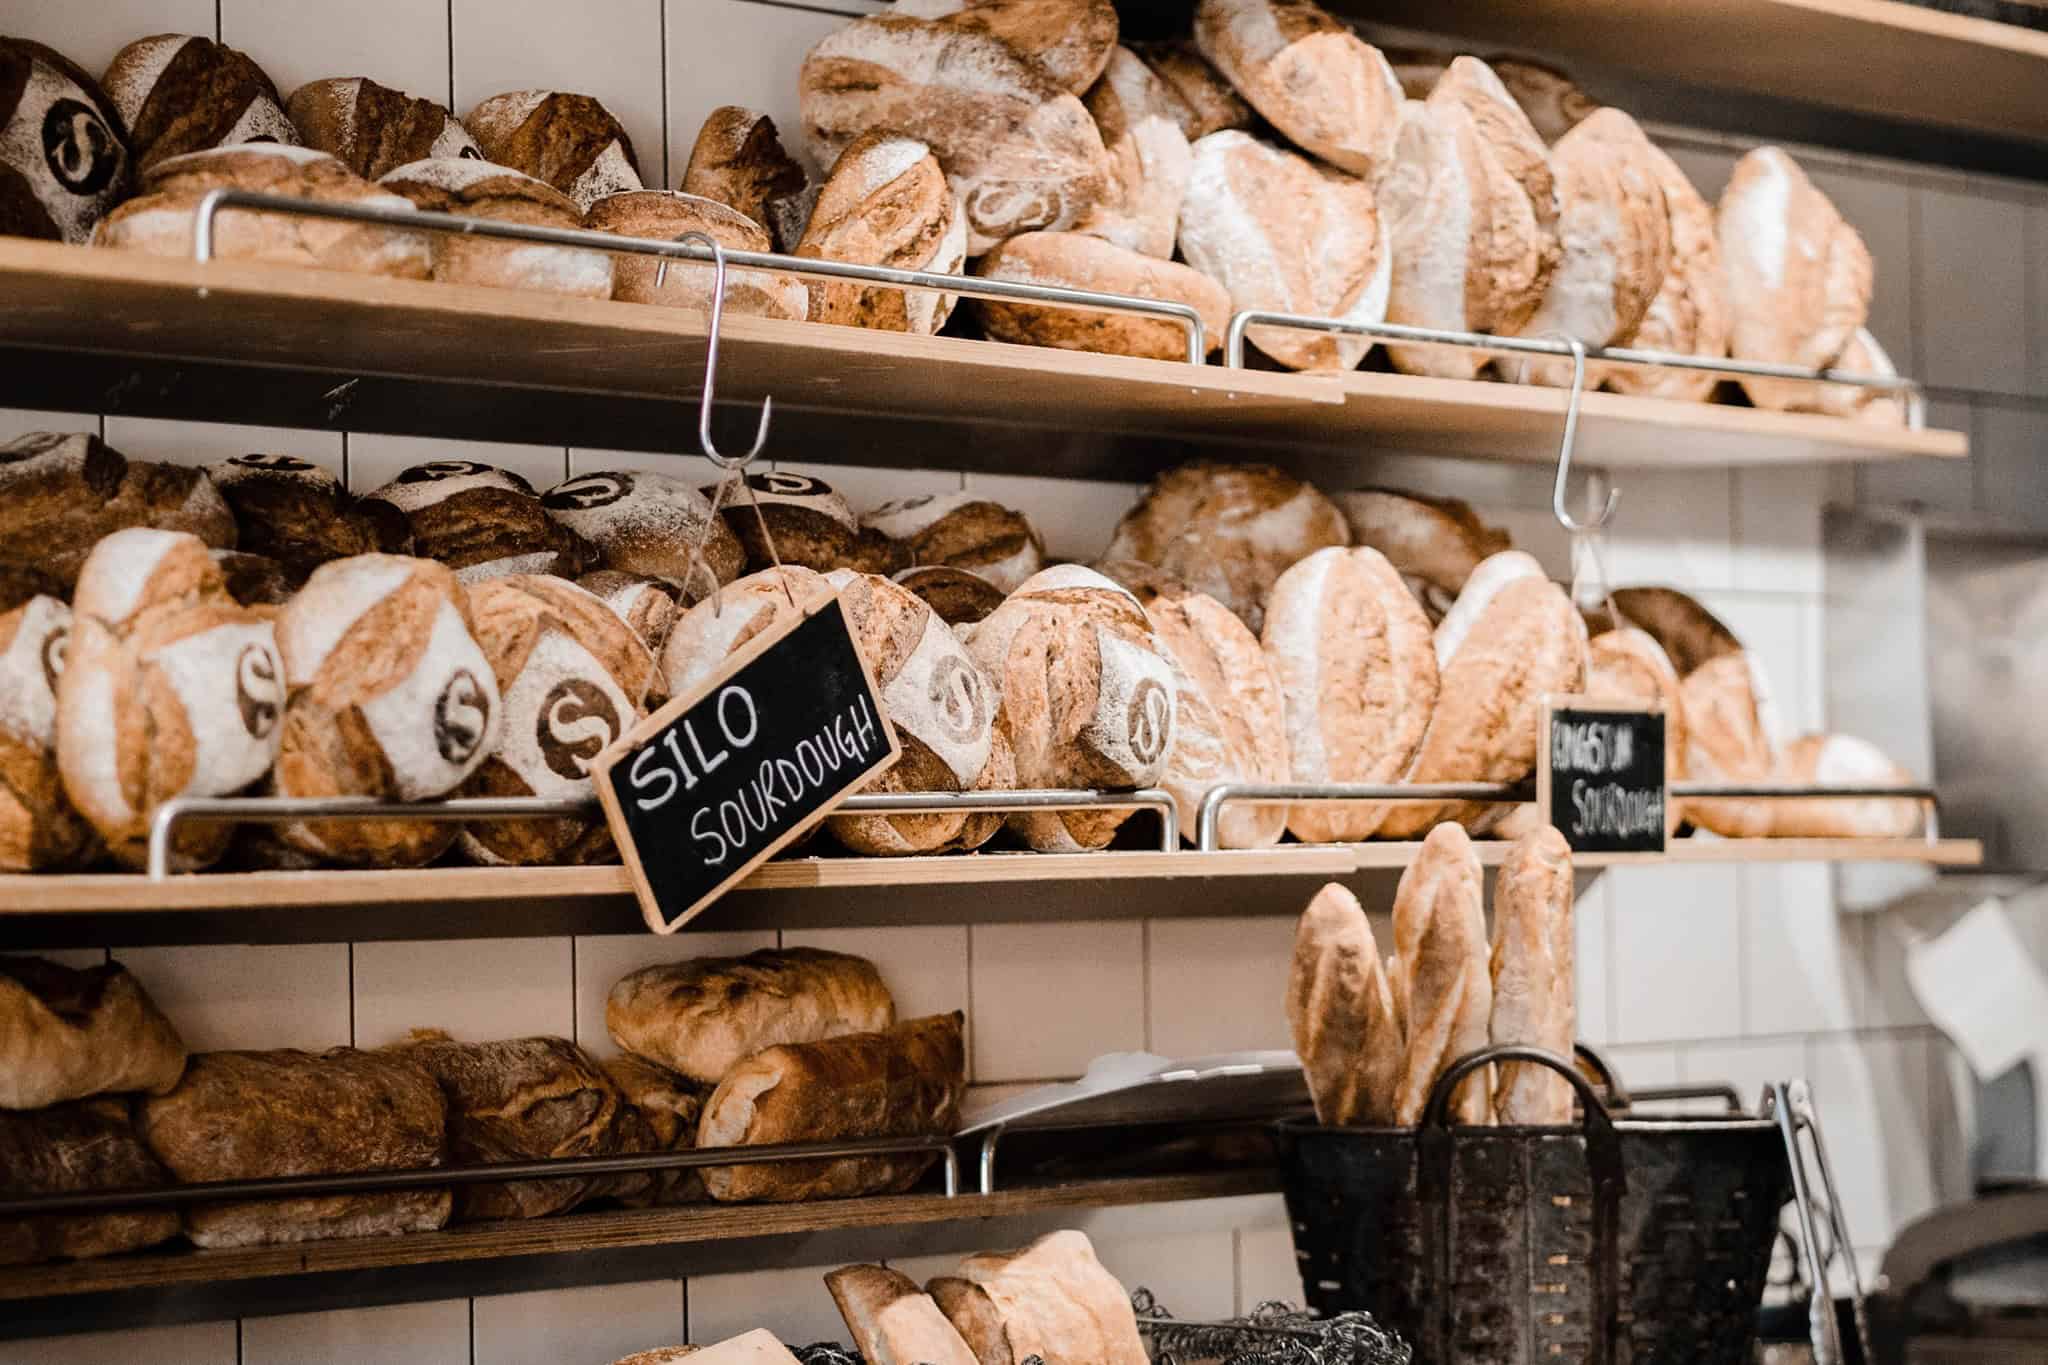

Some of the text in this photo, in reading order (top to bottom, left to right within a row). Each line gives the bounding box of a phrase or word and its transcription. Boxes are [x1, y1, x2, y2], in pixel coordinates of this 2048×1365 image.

[547, 686, 612, 776] S
[629, 684, 759, 811] SILO
[1130, 686, 1168, 756] S
[690, 692, 878, 865] SOURDOUGH
